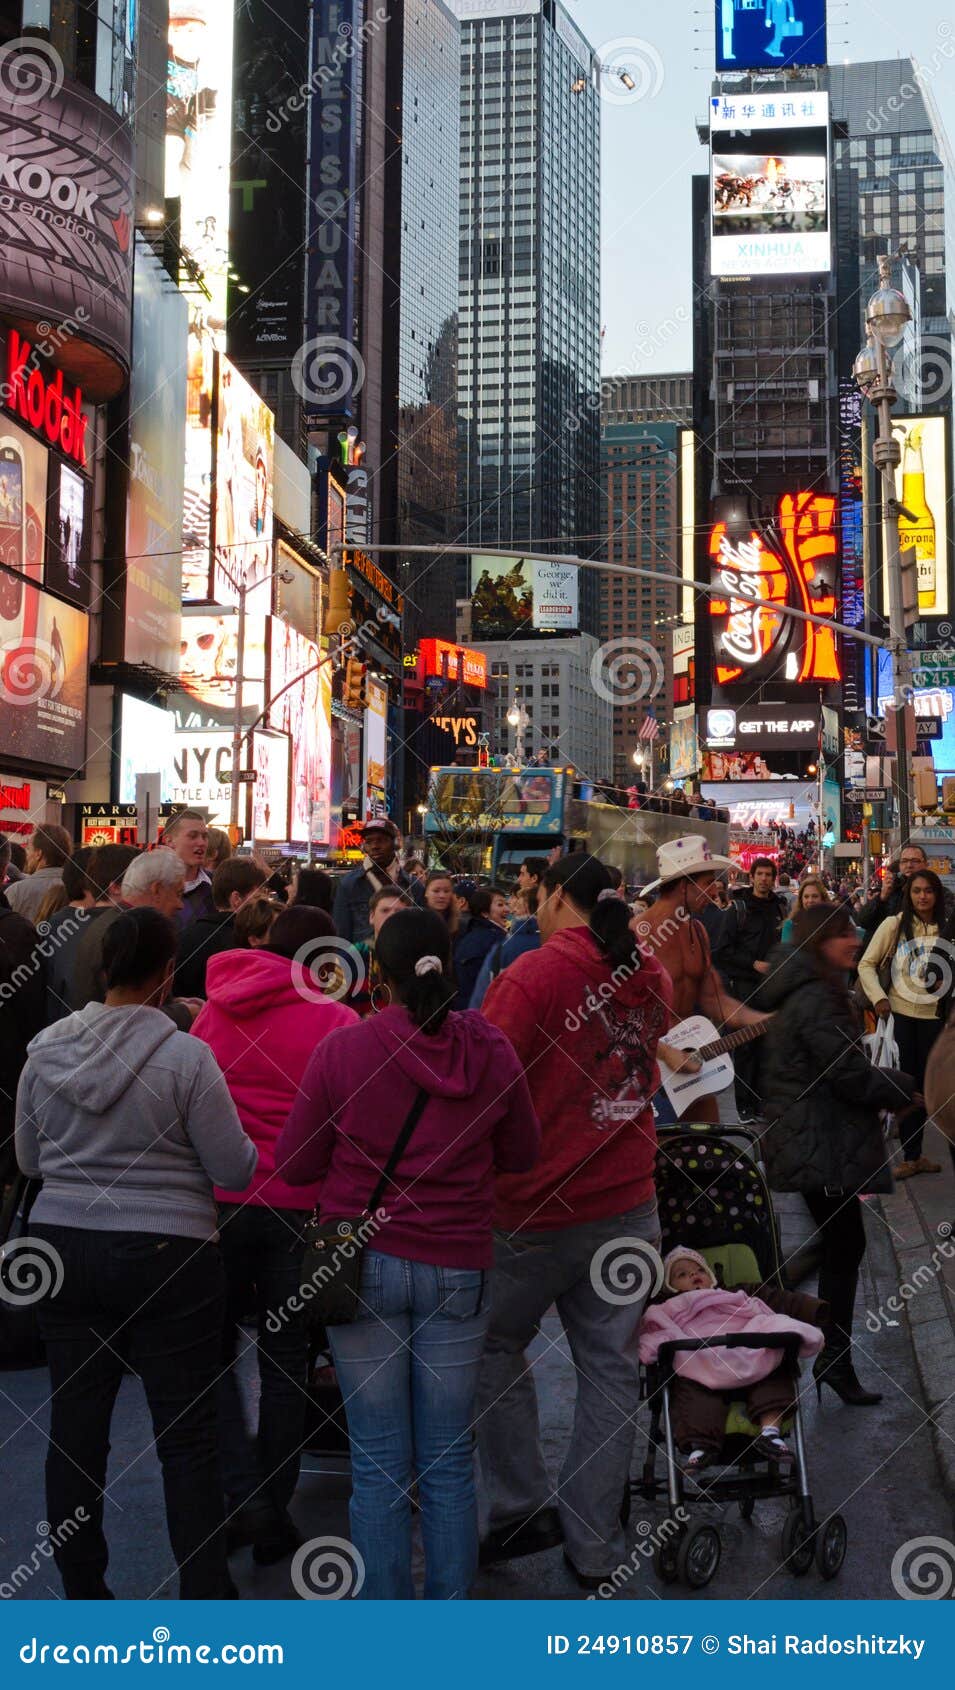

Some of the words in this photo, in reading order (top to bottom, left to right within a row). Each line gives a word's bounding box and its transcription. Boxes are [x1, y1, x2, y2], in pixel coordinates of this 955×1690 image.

[722, 102, 815, 120] 新华通讯社
[18, 201, 97, 244] emotion
[738, 241, 804, 257] XINHUA
[8, 329, 88, 467] Kodak
[538, 569, 574, 581] George,
[933, 672, 949, 686] 45
[739, 721, 763, 733] GET
[765, 721, 788, 732] THE
[790, 720, 815, 732] APP
[173, 788, 202, 801] TYLE
[209, 788, 233, 801] LAB
[868, 792, 882, 800] WAY
[82, 805, 178, 816] MARQIS
[921, 829, 953, 838] TITAN
